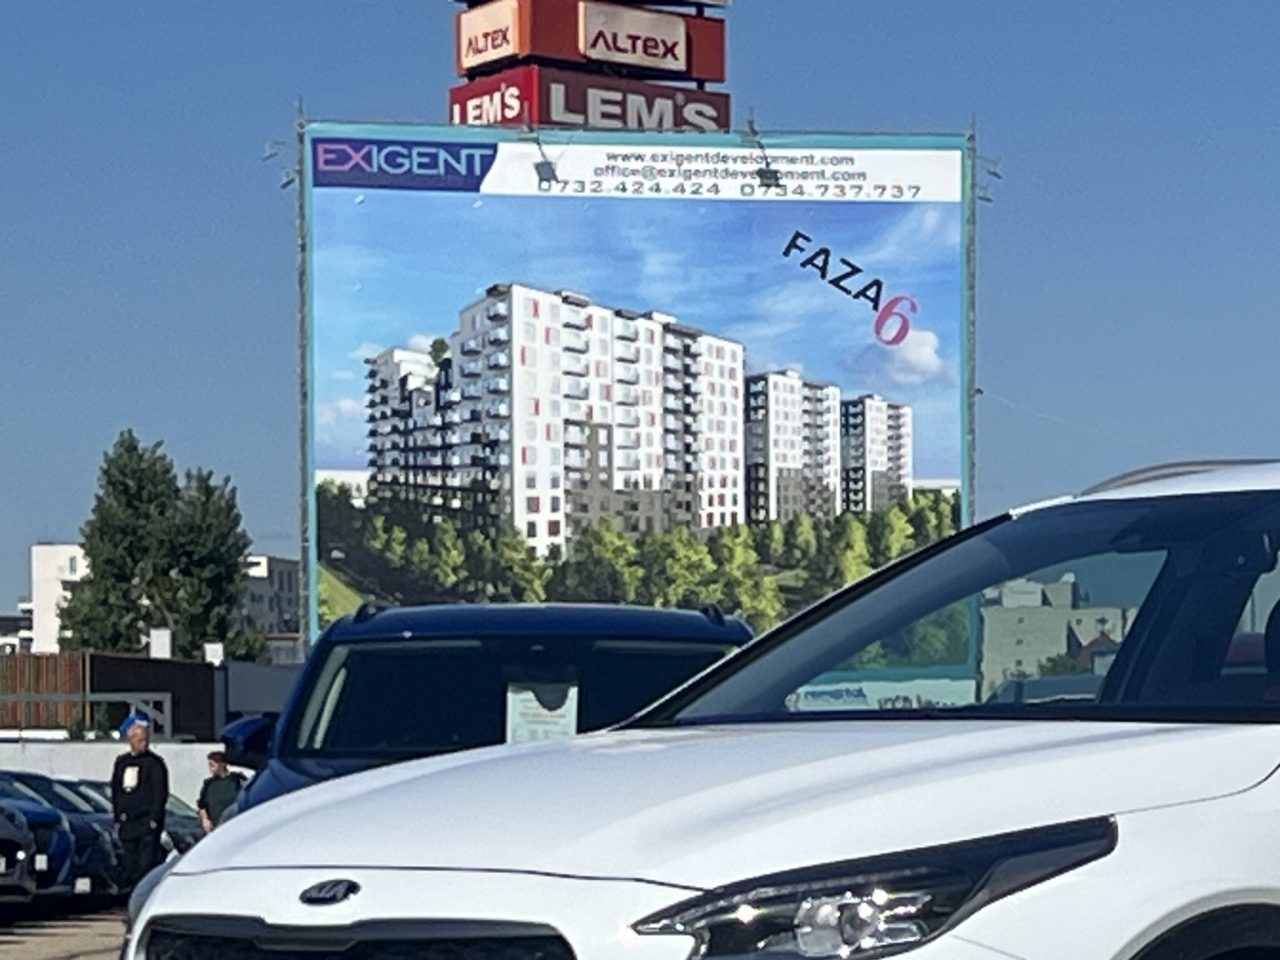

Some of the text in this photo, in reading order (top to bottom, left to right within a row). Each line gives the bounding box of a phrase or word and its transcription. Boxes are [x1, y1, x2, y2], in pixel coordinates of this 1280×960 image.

[452, 83, 521, 125] LEM'S
[550, 82, 719, 132] LEM'S
[316, 143, 494, 176] EXIGENT
[782, 230, 917, 346] FAZA 6
